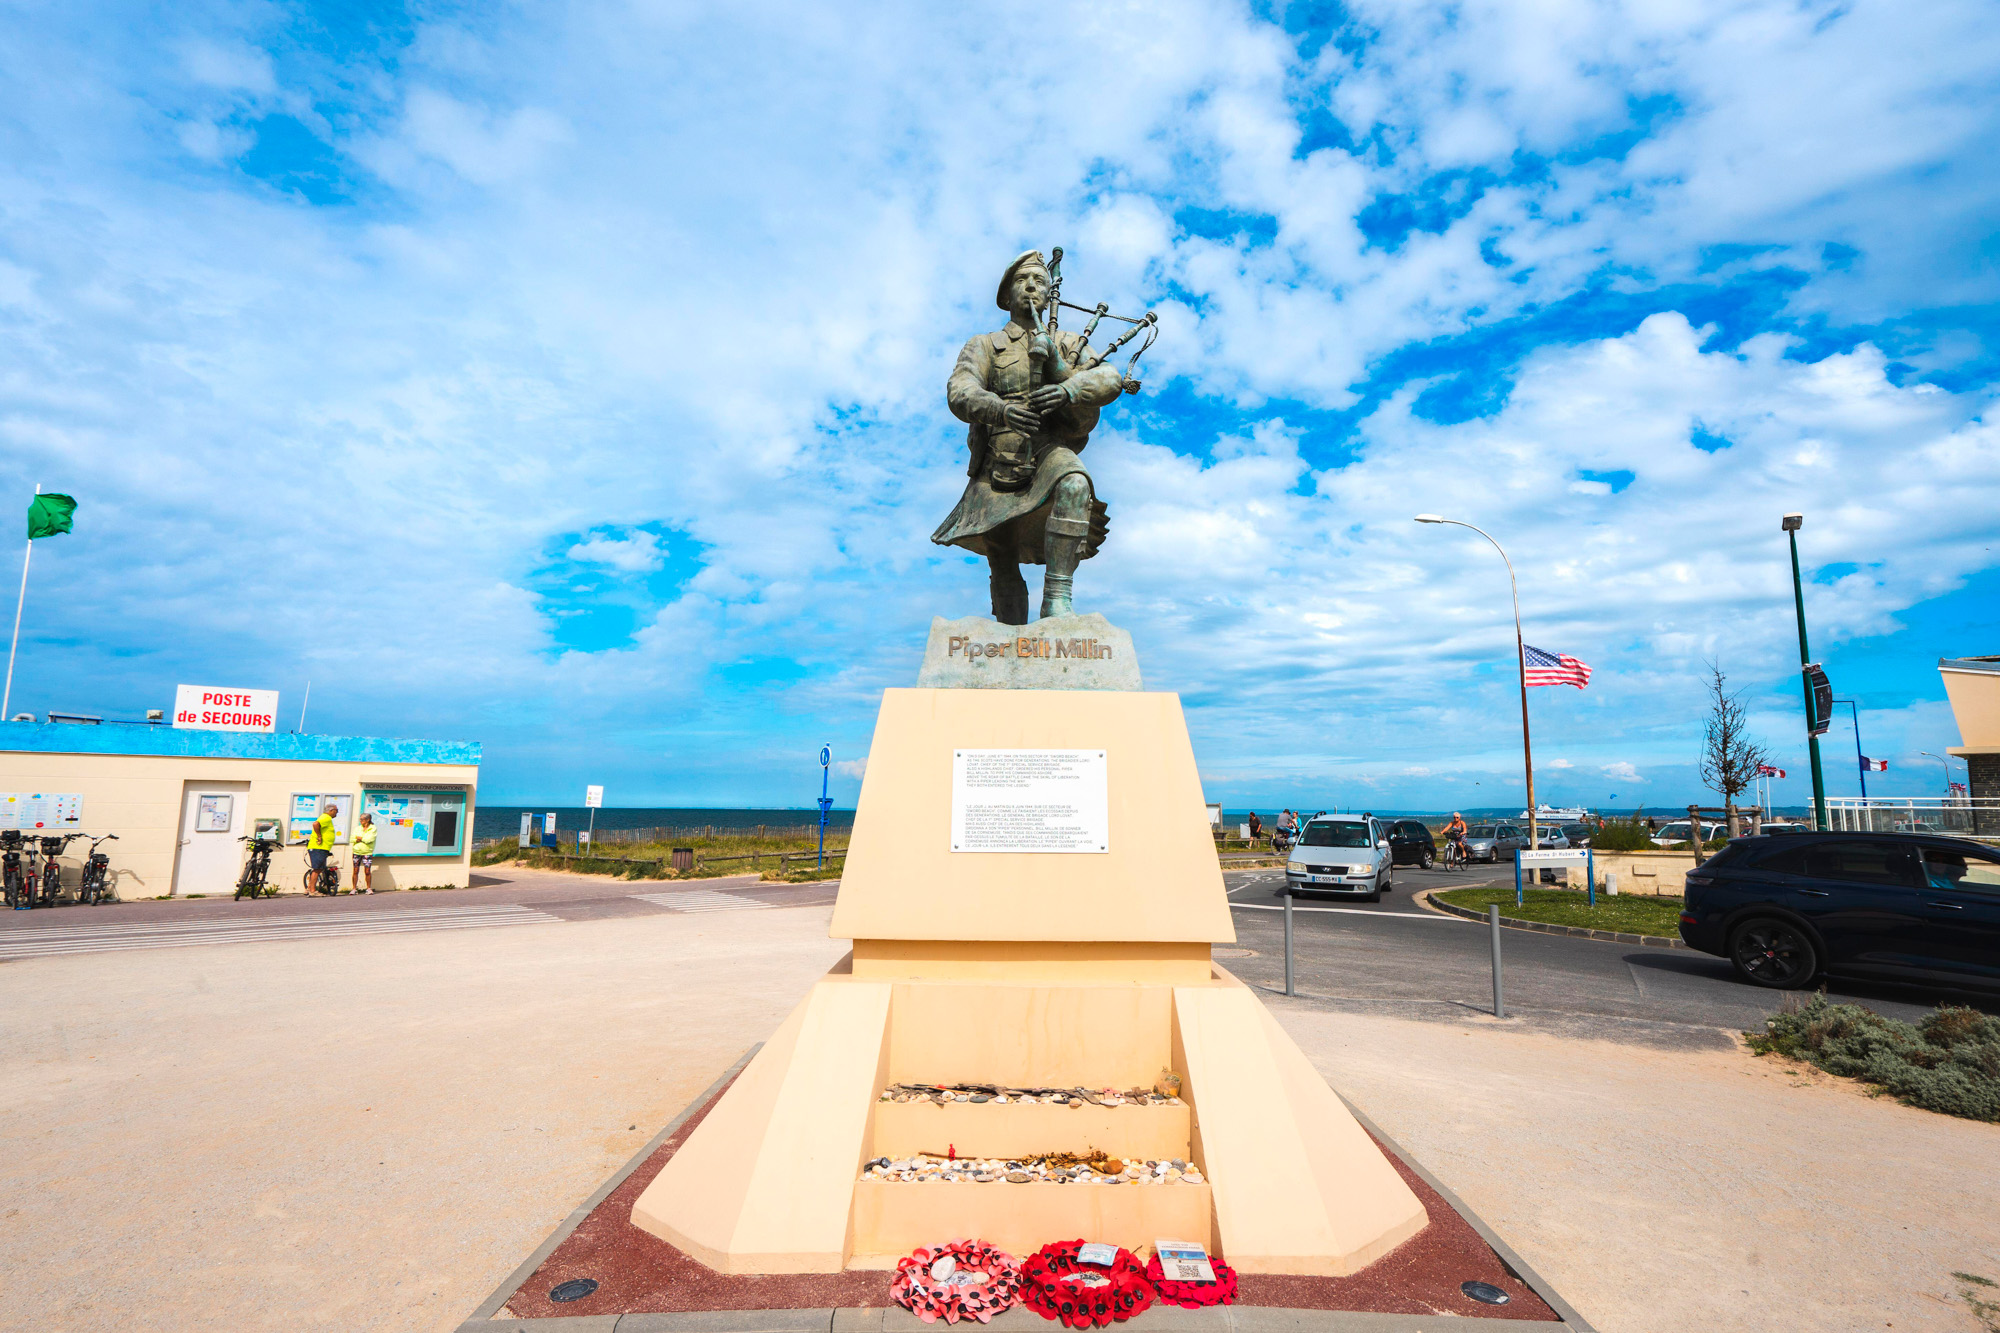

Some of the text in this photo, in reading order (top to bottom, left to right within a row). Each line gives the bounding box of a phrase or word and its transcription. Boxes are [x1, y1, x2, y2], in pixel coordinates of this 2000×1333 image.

[948, 636, 1113, 663] Piper Bill Millin
[202, 692, 251, 707] POSTE
[178, 710, 272, 727] de SECOURS
